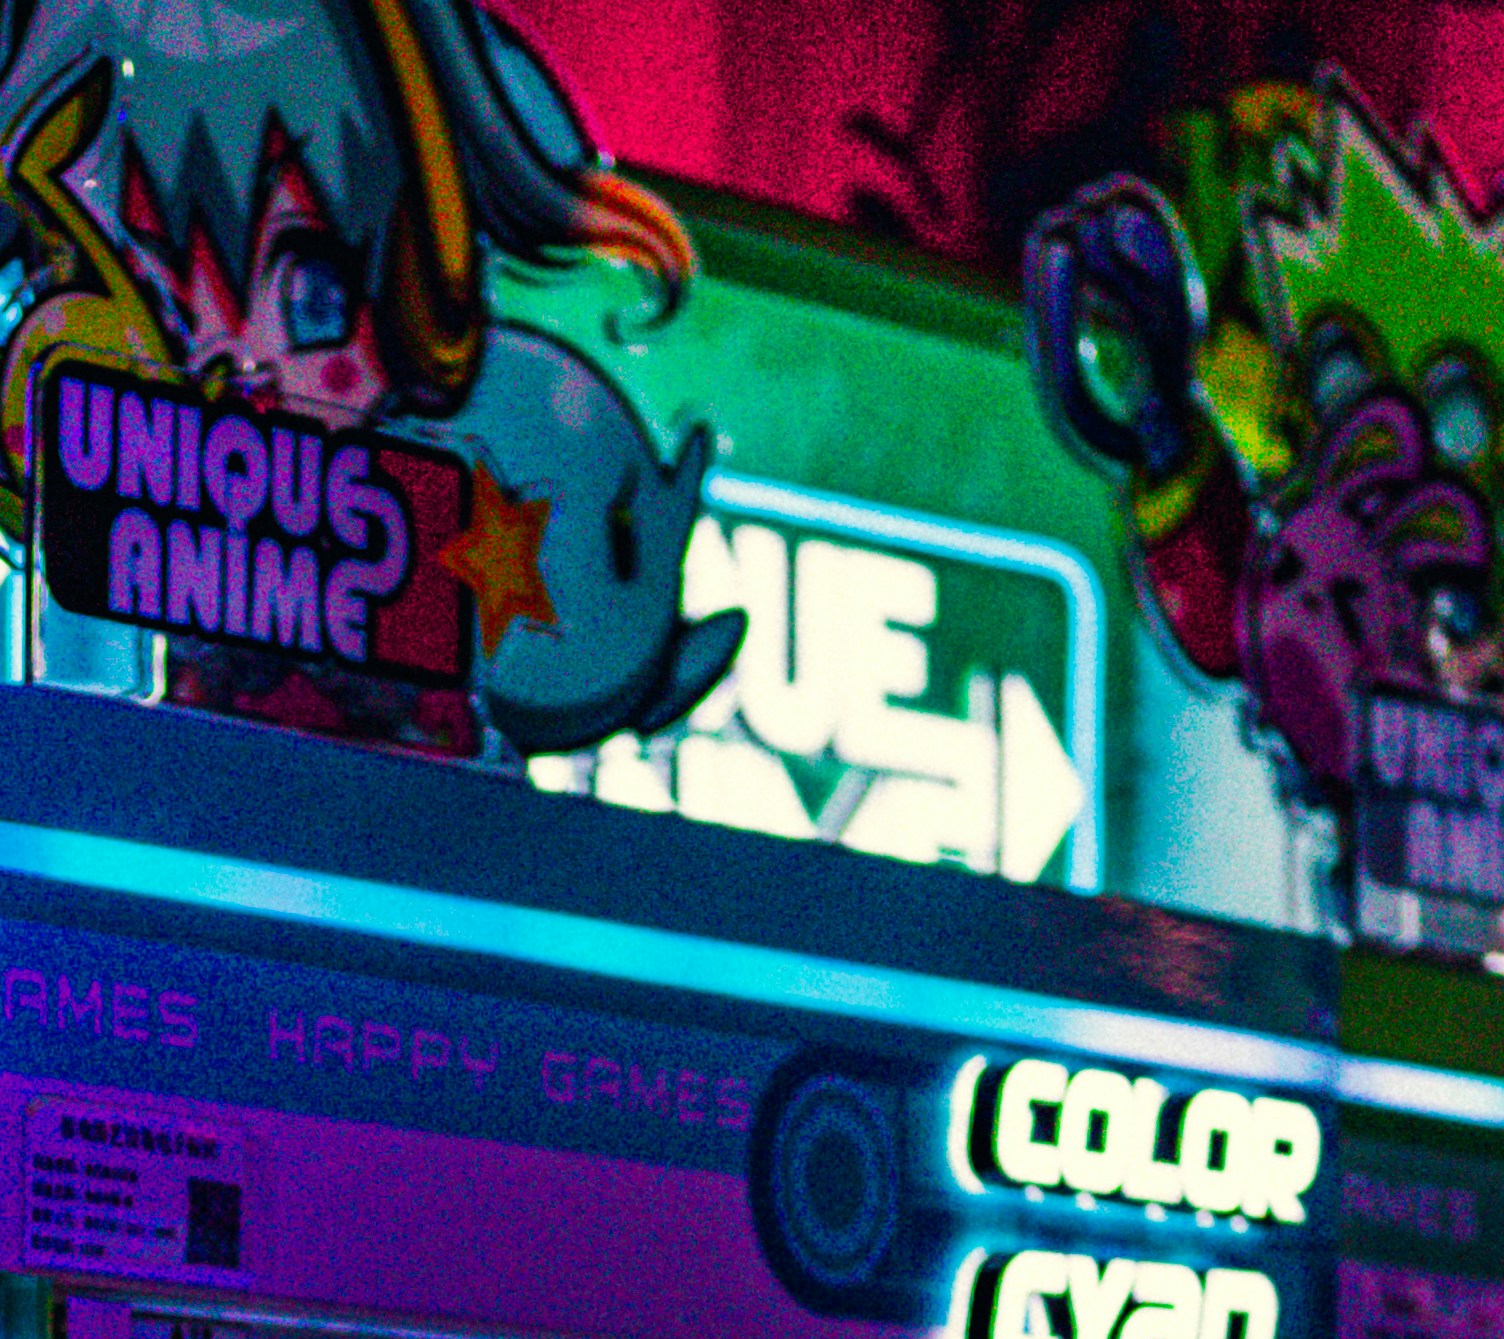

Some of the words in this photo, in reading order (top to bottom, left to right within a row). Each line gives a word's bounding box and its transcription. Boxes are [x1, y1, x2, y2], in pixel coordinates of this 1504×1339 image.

[58, 375, 371, 549] UNIQUE
[107, 506, 369, 663] ANIME
[267, 1008, 499, 1088] HAPPY
[541, 1050, 752, 1132] GAMES
[993, 1058, 1321, 1223] COLOR
